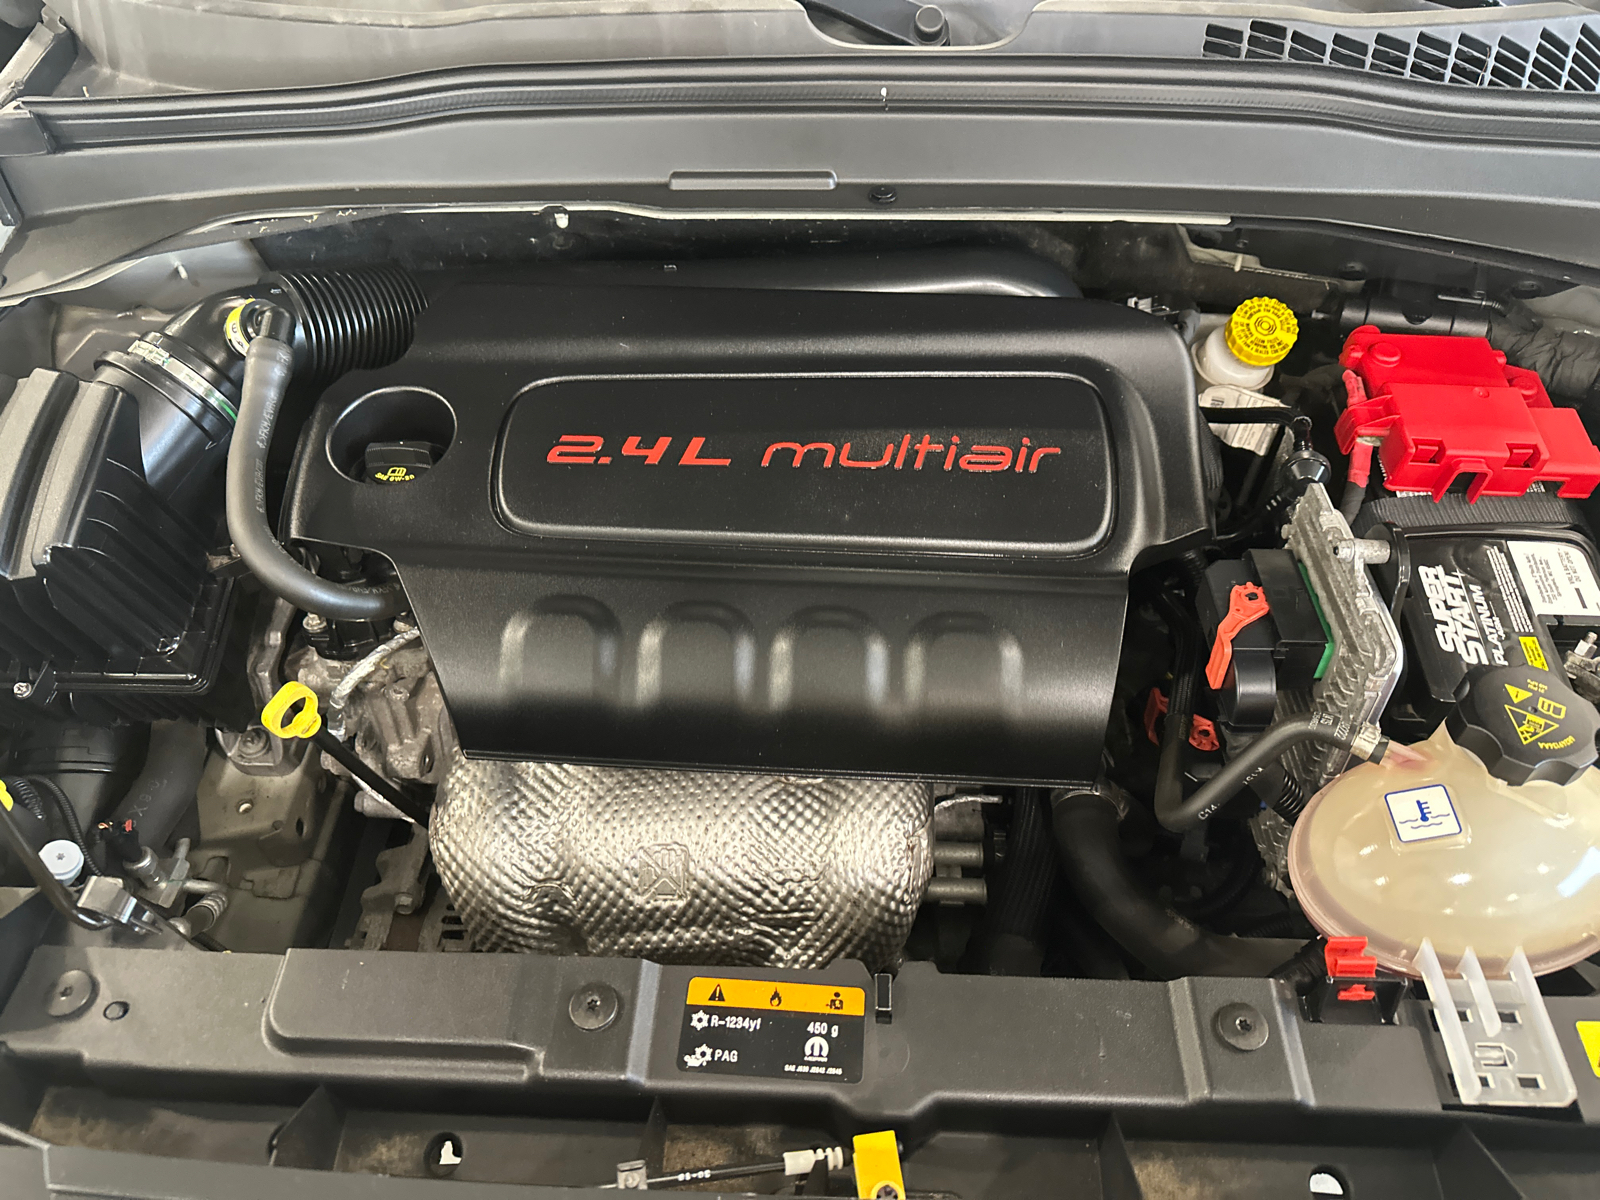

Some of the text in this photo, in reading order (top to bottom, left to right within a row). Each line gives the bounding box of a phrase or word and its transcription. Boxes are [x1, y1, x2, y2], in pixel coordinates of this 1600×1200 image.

[760, 433, 1063, 474] multiair
[1418, 565, 1456, 653] SUPER
[1439, 563, 1490, 666] START
[1468, 584, 1509, 667] PLATINUM
[710, 1015, 761, 1031] R-1234yf
[806, 1021, 840, 1038] 450 g
[714, 1049, 738, 1062] PAG
